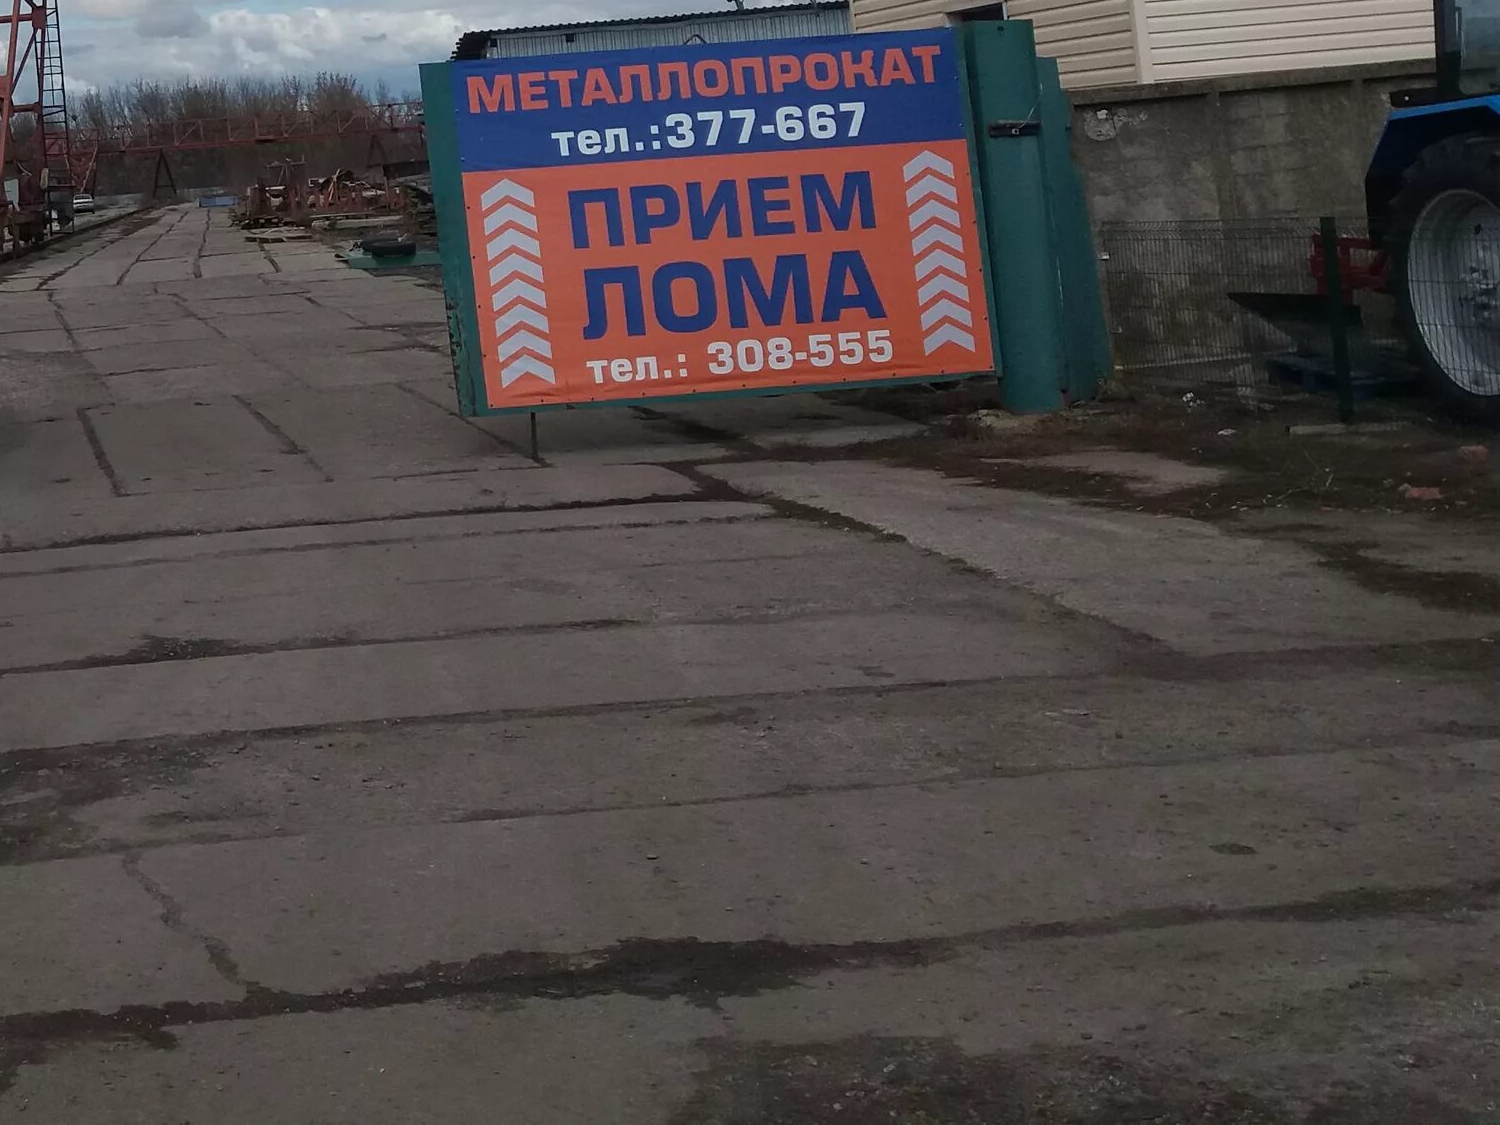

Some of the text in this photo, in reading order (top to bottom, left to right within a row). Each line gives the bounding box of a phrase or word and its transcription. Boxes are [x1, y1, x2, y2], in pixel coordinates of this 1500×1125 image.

[466, 45, 942, 114] МЕТАЛЛОПРОКАТ
[567, 170, 877, 250] ПРИЕМ
[582, 250, 888, 340] ЛОМА
[586, 330, 893, 384] тел.: 308-555
